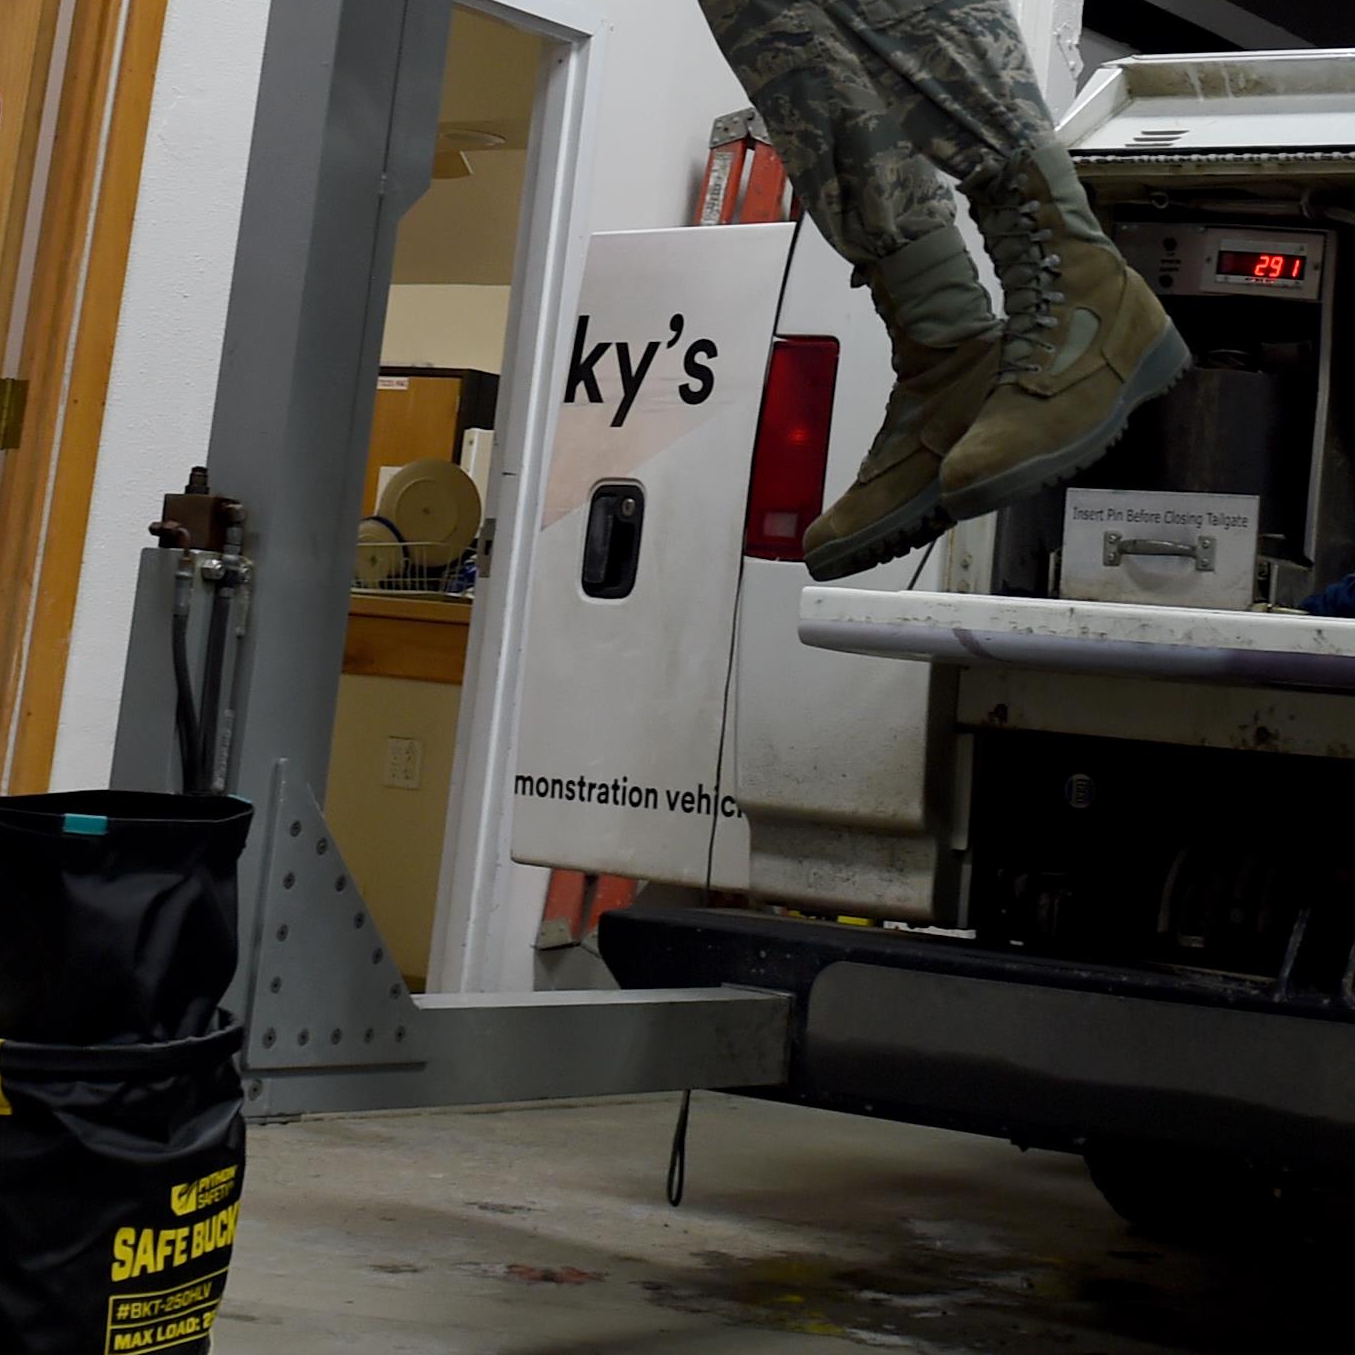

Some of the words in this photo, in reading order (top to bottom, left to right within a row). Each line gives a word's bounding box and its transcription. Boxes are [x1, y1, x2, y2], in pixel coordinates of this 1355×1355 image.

[1253, 254, 1301, 278] 291
[563, 313, 719, 428] ky's
[1072, 506, 1105, 522] Insert
[1107, 508, 1124, 522] Pin
[1126, 509, 1161, 524] Before
[1163, 510, 1203, 529] Closing
[1205, 512, 1249, 530] Tailgate
[514, 774, 659, 810] monstration
[665, 784, 743, 818] vehic
[111, 1227, 190, 1282] SAFE
[114, 1328, 154, 1351] MAX
[156, 1316, 201, 1342] LOAD:
